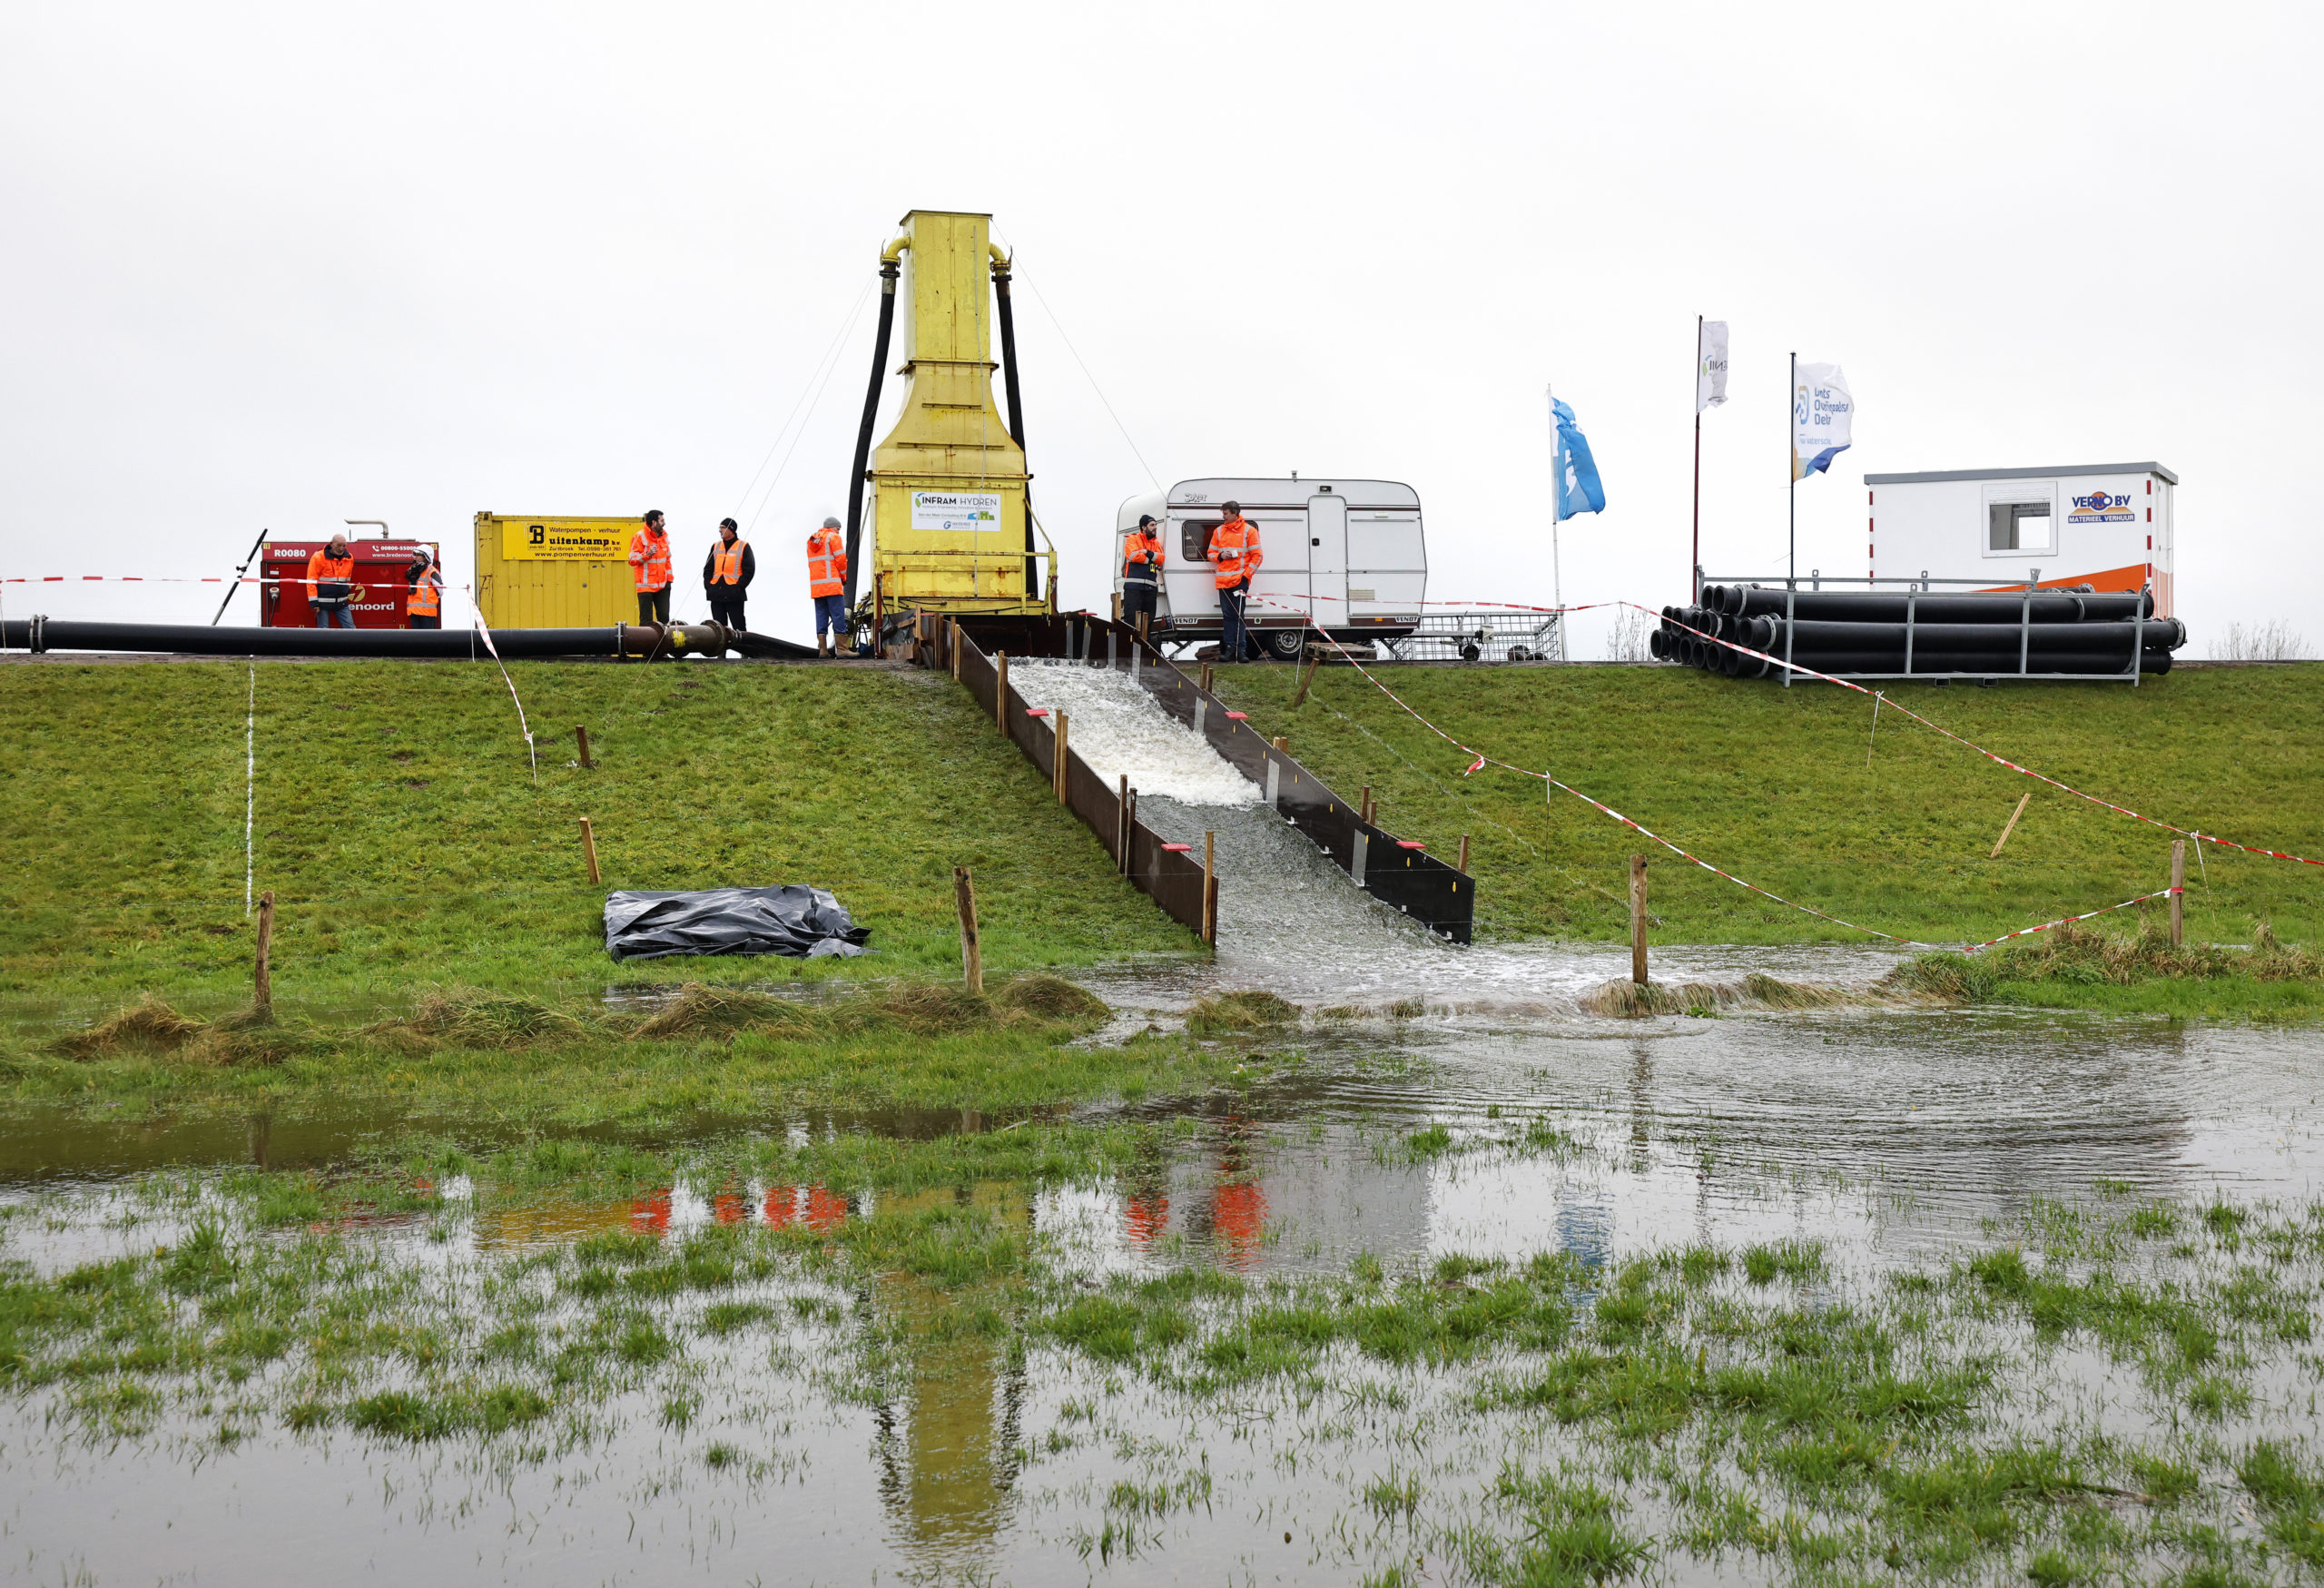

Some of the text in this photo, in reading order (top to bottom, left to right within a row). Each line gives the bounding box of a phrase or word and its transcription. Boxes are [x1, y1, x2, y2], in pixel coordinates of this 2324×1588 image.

[921, 497, 997, 506] INFRAM HYDREN
[2072, 495, 2131, 508] VERNO BV
[274, 549, 306, 557] R0080
[349, 601, 394, 610] enoord
